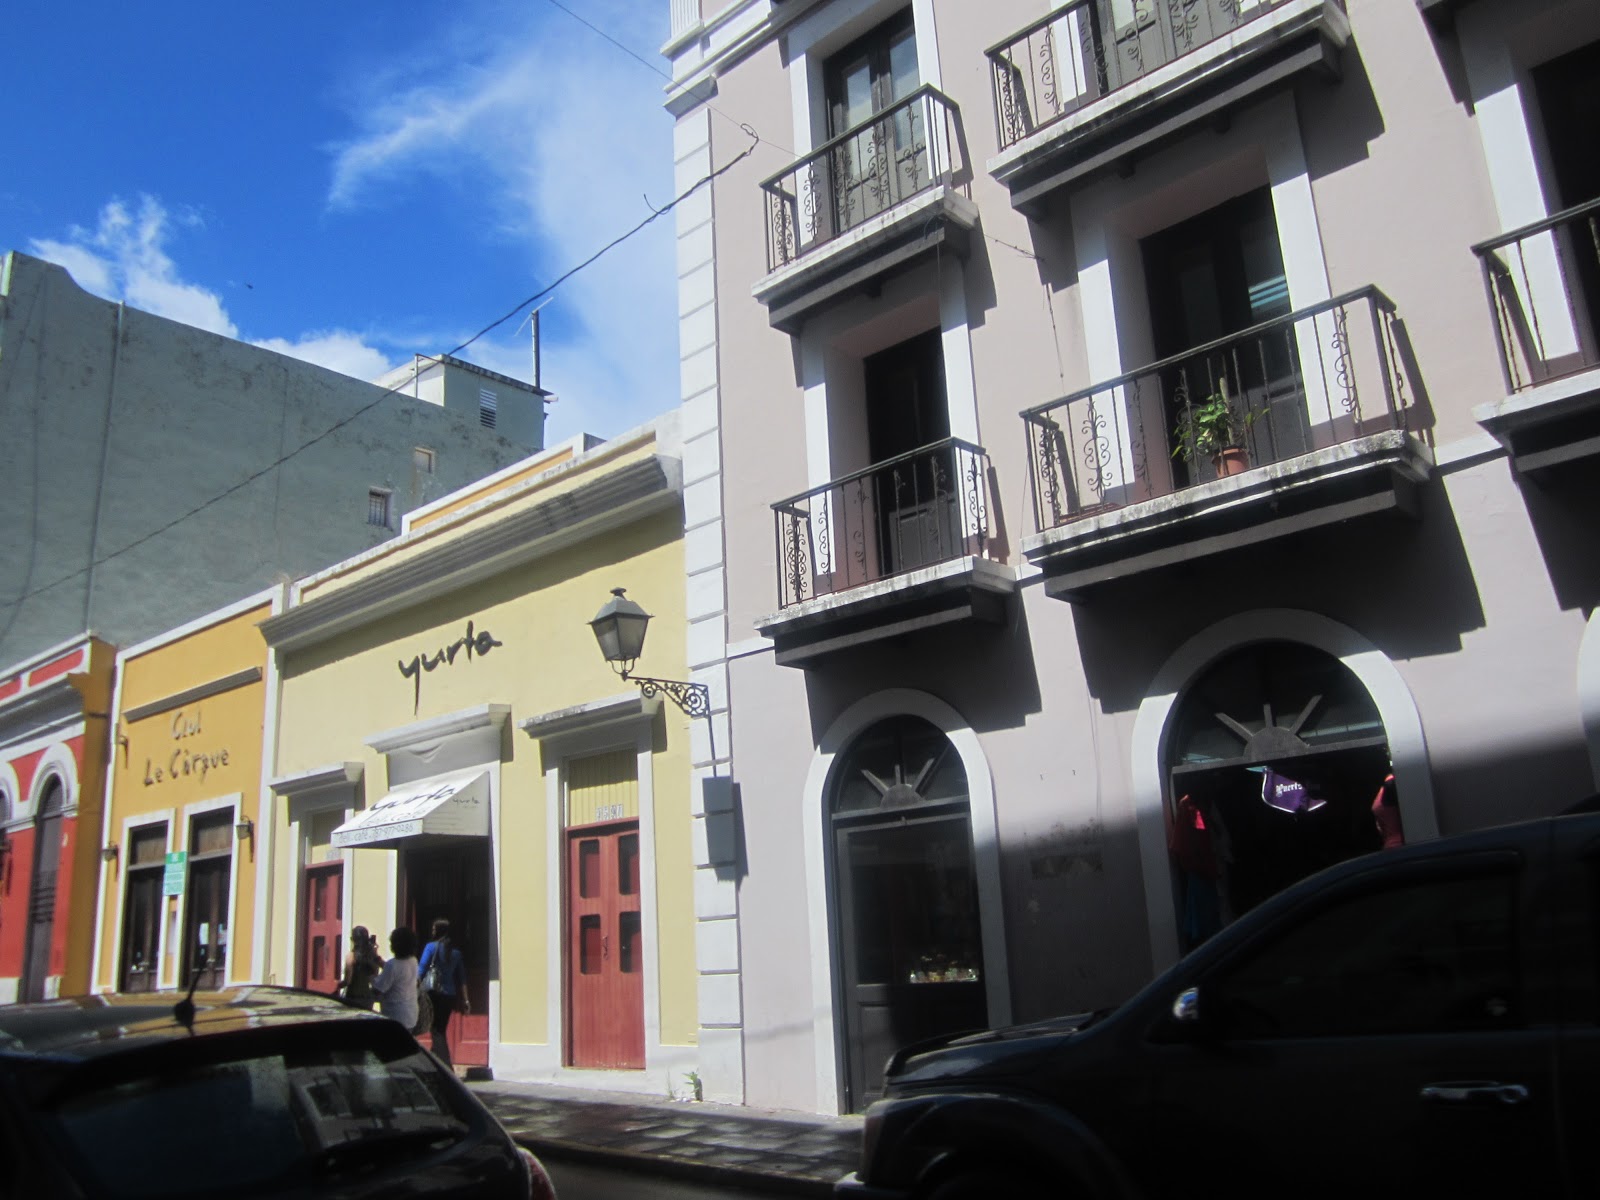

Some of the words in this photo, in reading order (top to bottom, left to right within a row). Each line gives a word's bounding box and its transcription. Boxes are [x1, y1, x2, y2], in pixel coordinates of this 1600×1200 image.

[398, 619, 503, 717] yurta
[144, 757, 164, 787] Le
[169, 748, 230, 784] Cirque
[360, 784, 455, 824] yurta
